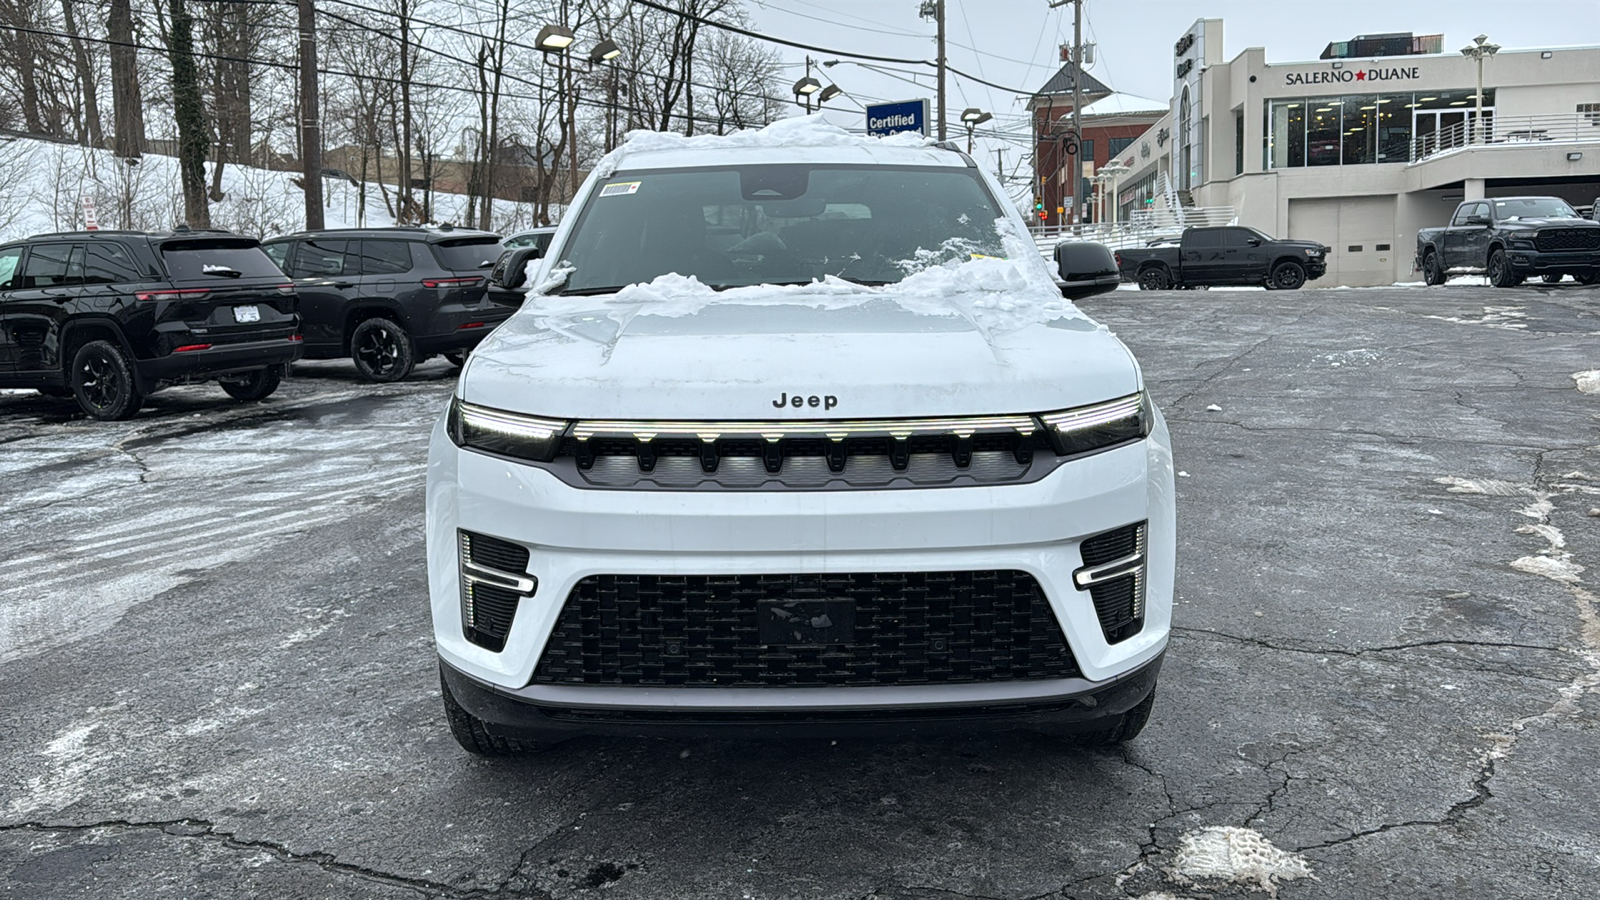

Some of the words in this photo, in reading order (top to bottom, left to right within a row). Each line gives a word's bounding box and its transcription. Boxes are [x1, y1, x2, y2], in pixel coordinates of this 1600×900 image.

[1286, 70, 1354, 86] SALERNO
[1368, 67, 1420, 81] DUANE
[869, 113, 915, 128] Certified
[772, 392, 838, 411] Jeep
